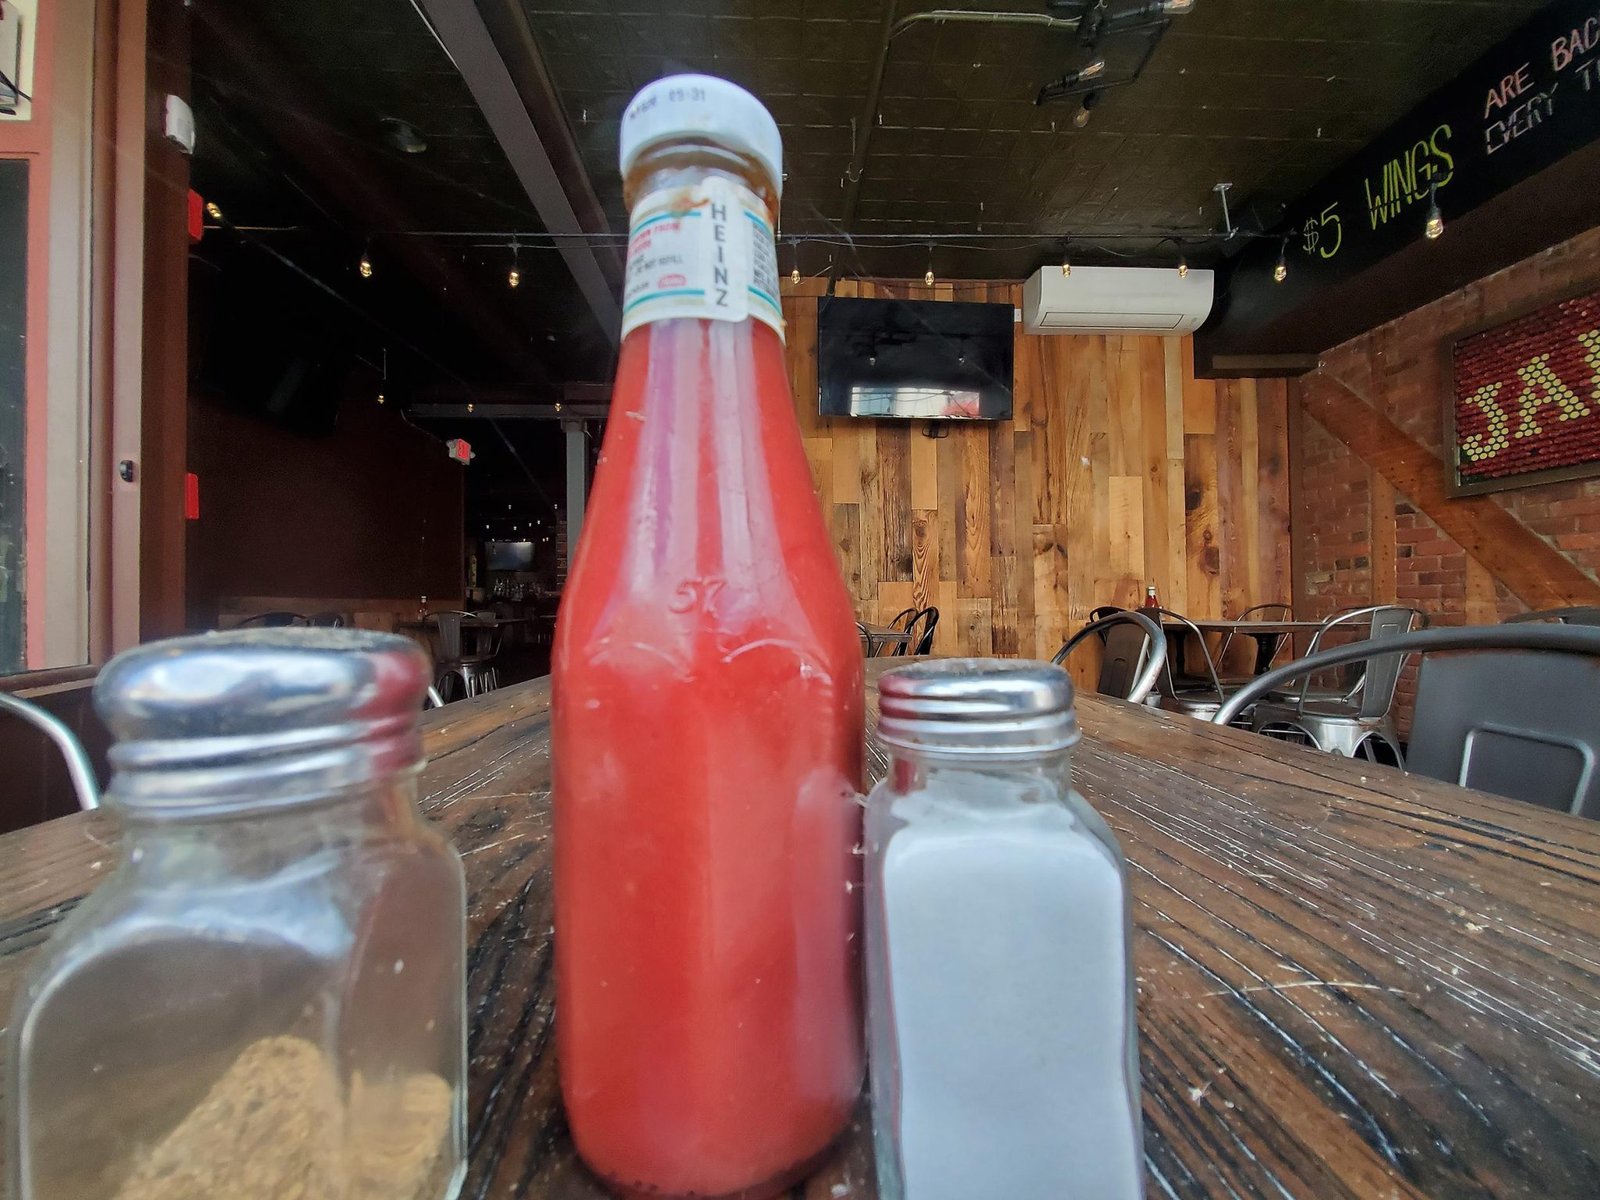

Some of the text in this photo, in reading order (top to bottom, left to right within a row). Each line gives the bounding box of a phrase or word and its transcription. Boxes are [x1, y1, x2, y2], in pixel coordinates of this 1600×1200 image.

[1484, 16, 1600, 119] ARE BAC
[1574, 57, 1600, 91] T
[1303, 124, 1454, 259] $5 WINGS
[711, 203, 729, 307] HEINZ
[1464, 329, 1600, 462] JA
[670, 578, 727, 615] 57
